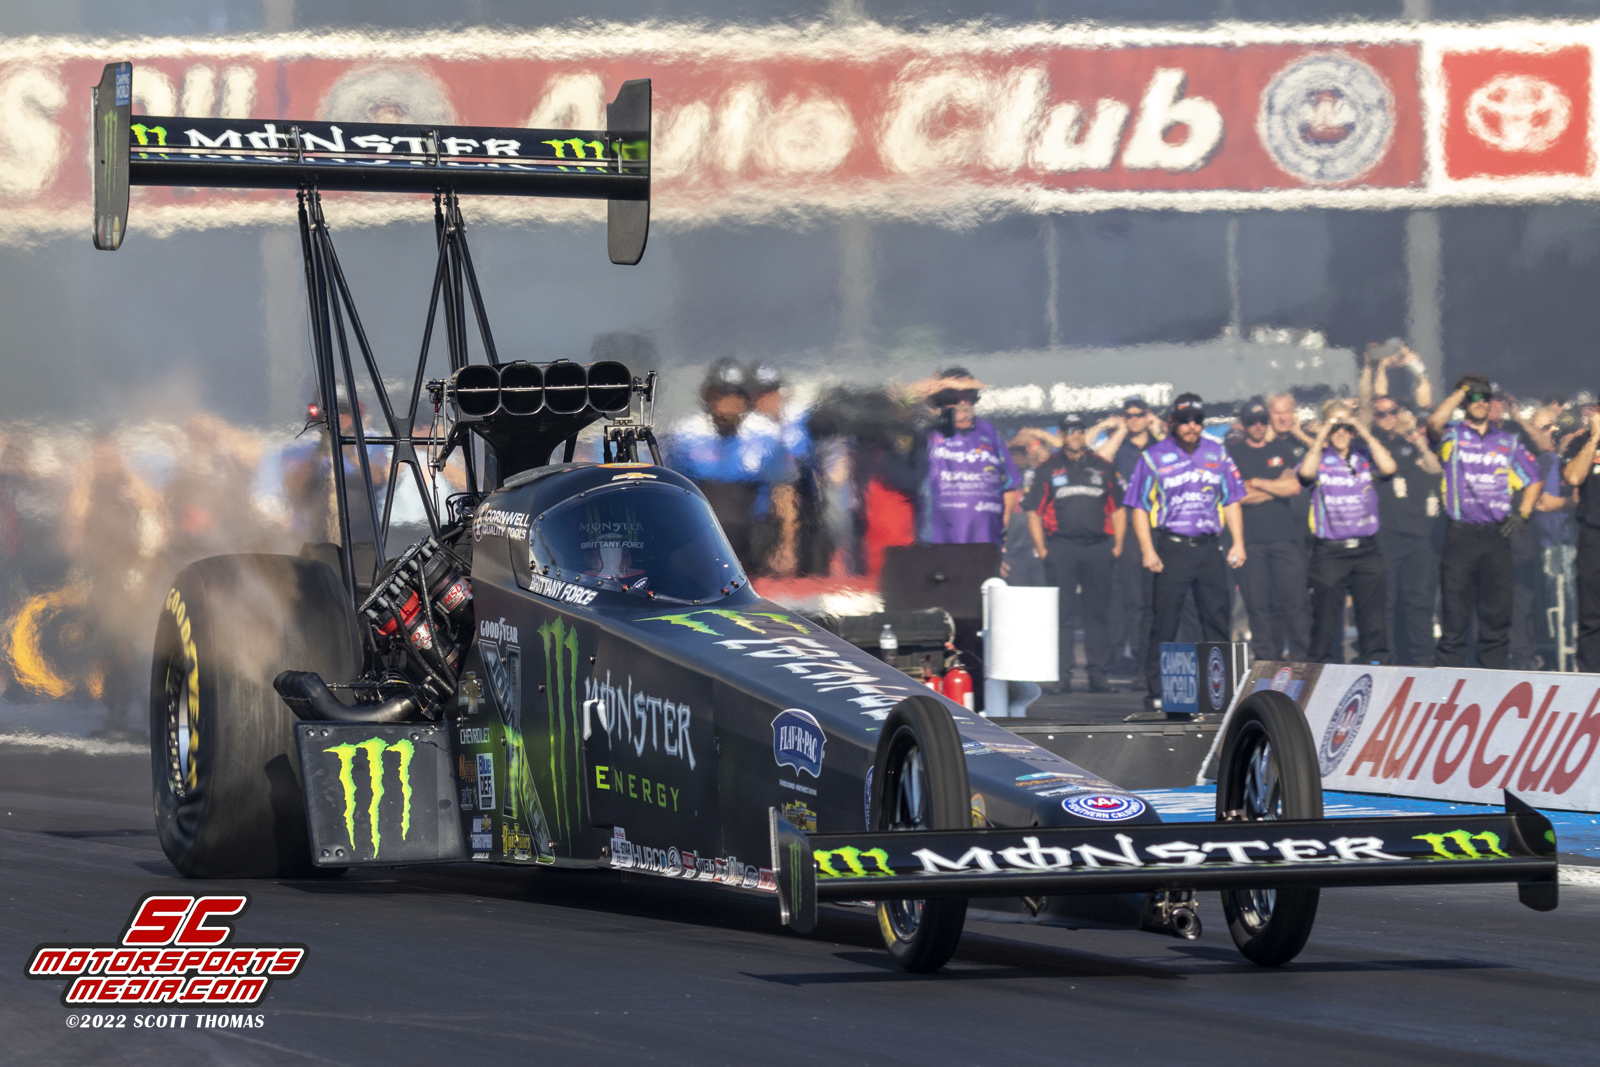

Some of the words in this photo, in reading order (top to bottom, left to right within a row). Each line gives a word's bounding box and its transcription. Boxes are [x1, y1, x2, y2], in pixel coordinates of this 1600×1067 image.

[184, 123, 530, 166] MONSTER
[484, 509, 530, 527] CORNWELL
[579, 520, 644, 533] MONSTER
[506, 526, 527, 540] TOOLS
[580, 540, 621, 549] BRITTANY
[621, 540, 645, 549] FORCE
[443, 583, 463, 606] MSD
[529, 574, 566, 599] BRITTANY
[561, 582, 599, 606] FORCE
[1161, 651, 1197, 675] CAMPING
[1162, 675, 1198, 704] WORLD
[582, 669, 697, 771] MONSTER
[460, 727, 491, 744] CHEVROLET
[478, 755, 492, 775] Blue
[595, 765, 679, 812] ENERGY
[1086, 796, 1121, 807] AAA
[632, 844, 667, 873] HURCO
[911, 833, 1411, 874] MONSTER
